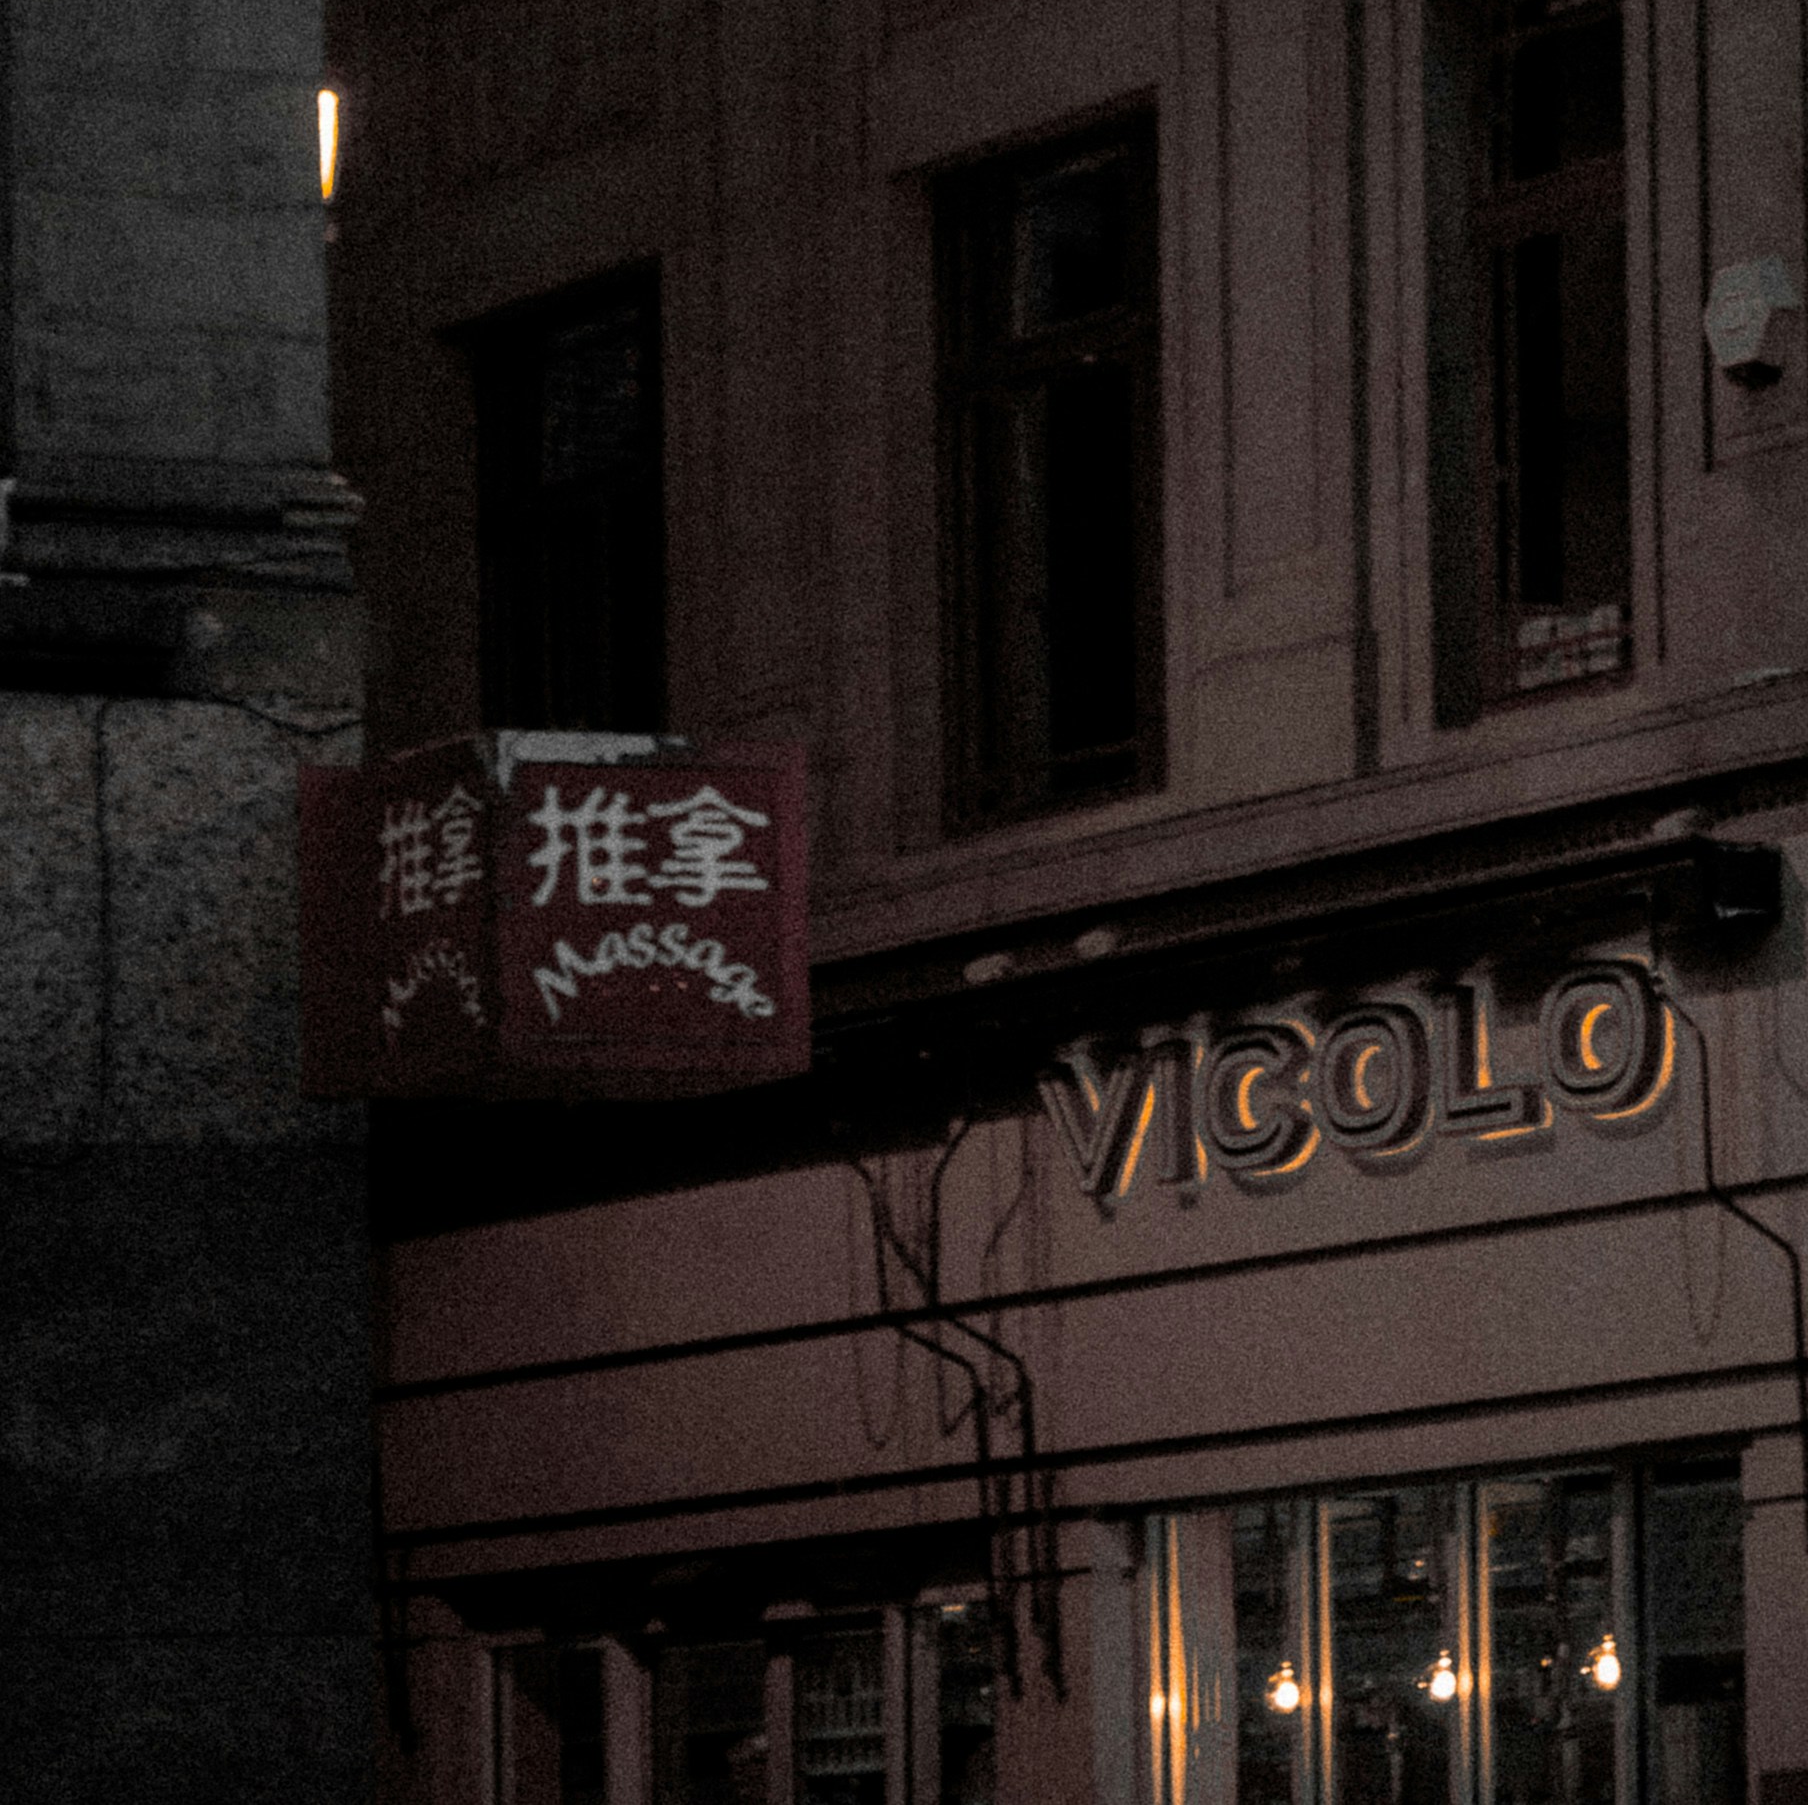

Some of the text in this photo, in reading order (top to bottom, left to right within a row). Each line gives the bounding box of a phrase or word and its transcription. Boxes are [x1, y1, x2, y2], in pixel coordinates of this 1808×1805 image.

[380, 787, 484, 920] 推拿
[528, 784, 771, 907] 推拿
[531, 922, 776, 1023] Massage
[1039, 956, 1678, 1202] VICOLO
